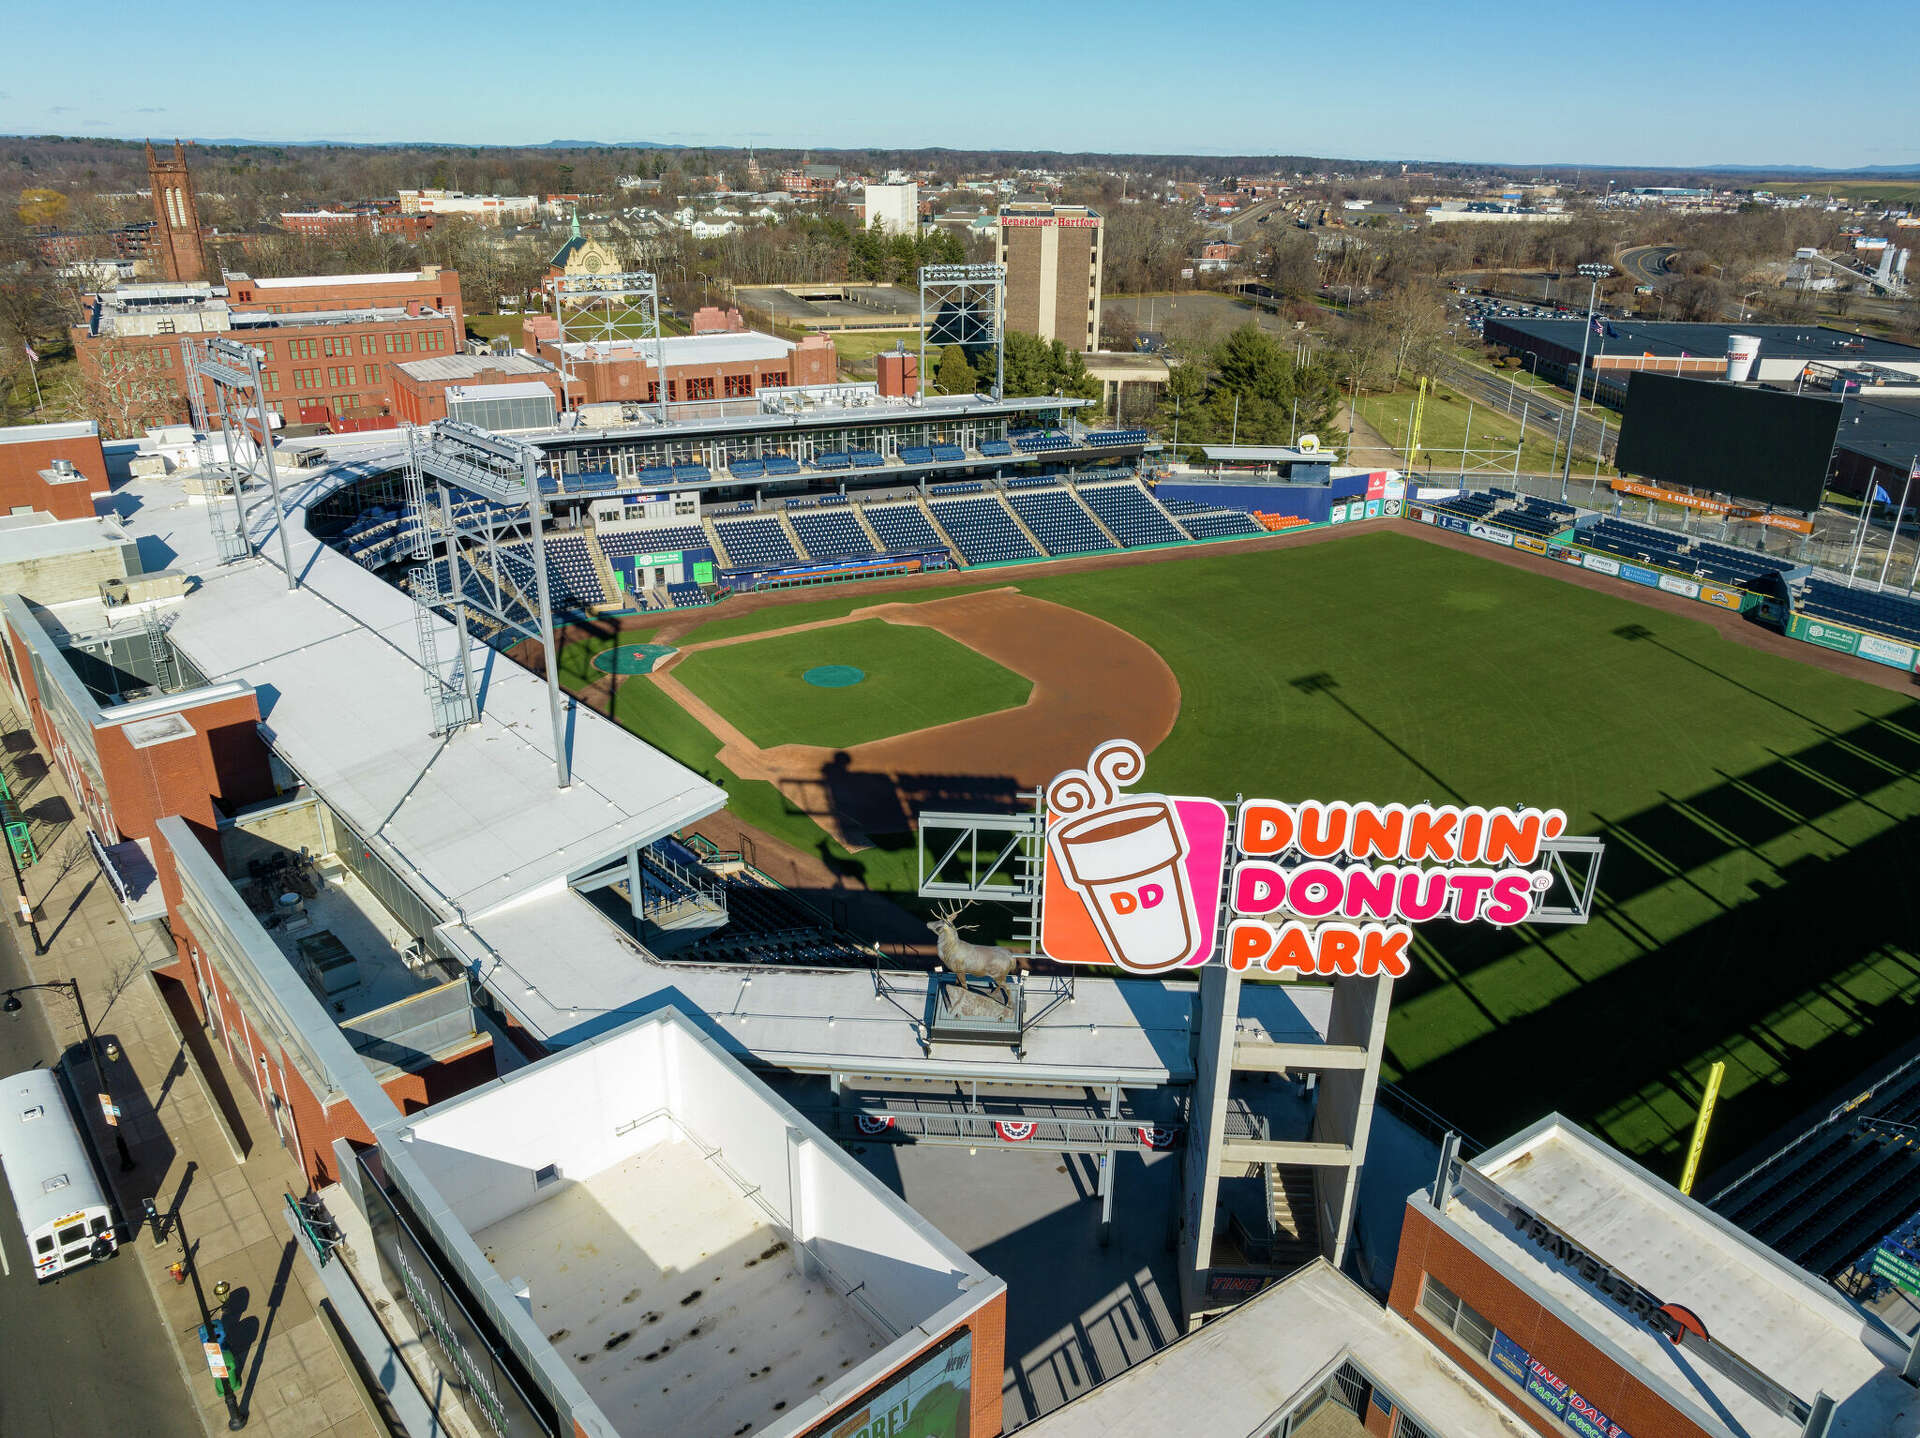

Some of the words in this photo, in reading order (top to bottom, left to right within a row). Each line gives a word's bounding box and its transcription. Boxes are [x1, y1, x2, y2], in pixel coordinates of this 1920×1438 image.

[1238, 800, 1566, 866] DUNKIN'
[1231, 861, 1533, 925] DONUTS
[1226, 920, 1412, 976] PARK
[1510, 1206, 1676, 1332] TRAVELERS
[1529, 1381, 1565, 1412] PARTY
[1568, 1412, 1606, 1438] PORC
